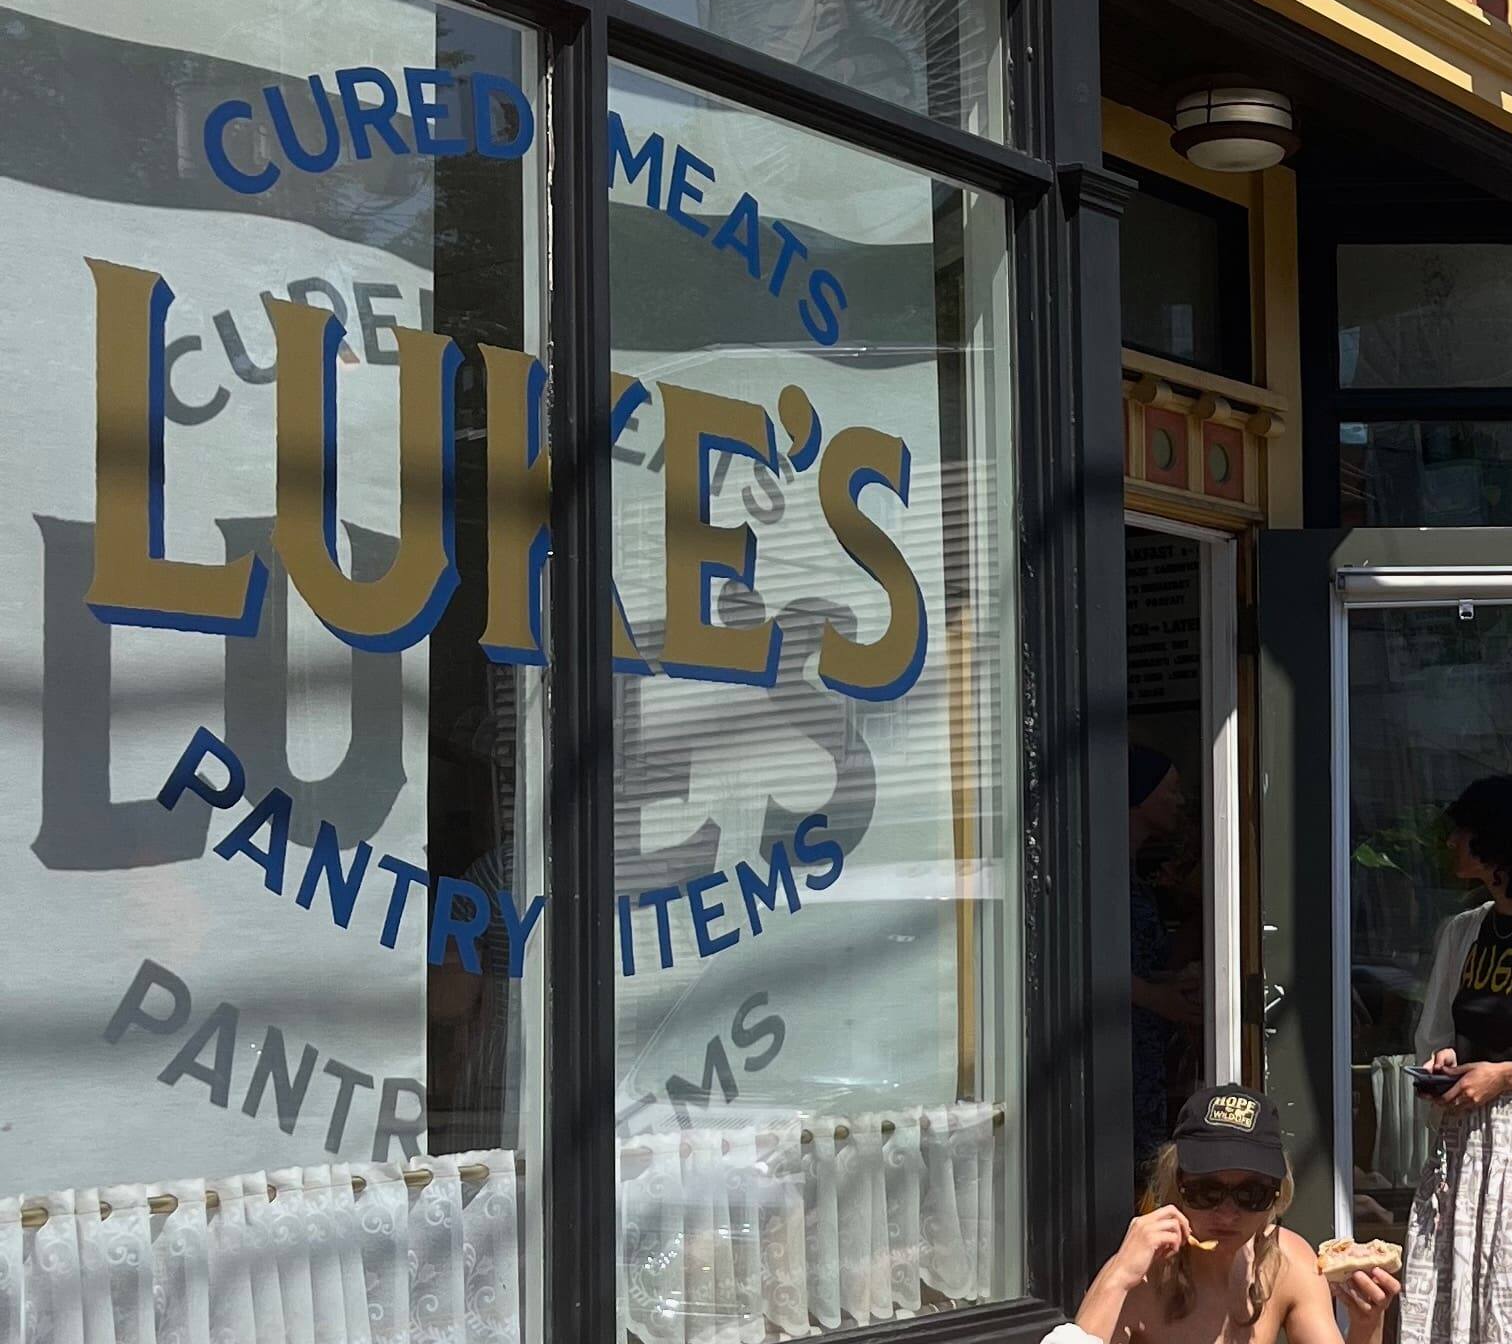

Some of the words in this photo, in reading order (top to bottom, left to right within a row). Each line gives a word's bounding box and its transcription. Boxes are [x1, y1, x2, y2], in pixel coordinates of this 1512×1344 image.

[205, 66, 535, 195] CURED
[608, 111, 849, 346] MEATS
[84, 256, 929, 702] LUKE'S
[157, 726, 546, 978] PANTRY
[617, 813, 845, 977] ITEMS
[1214, 1095, 1257, 1111] HOPE
